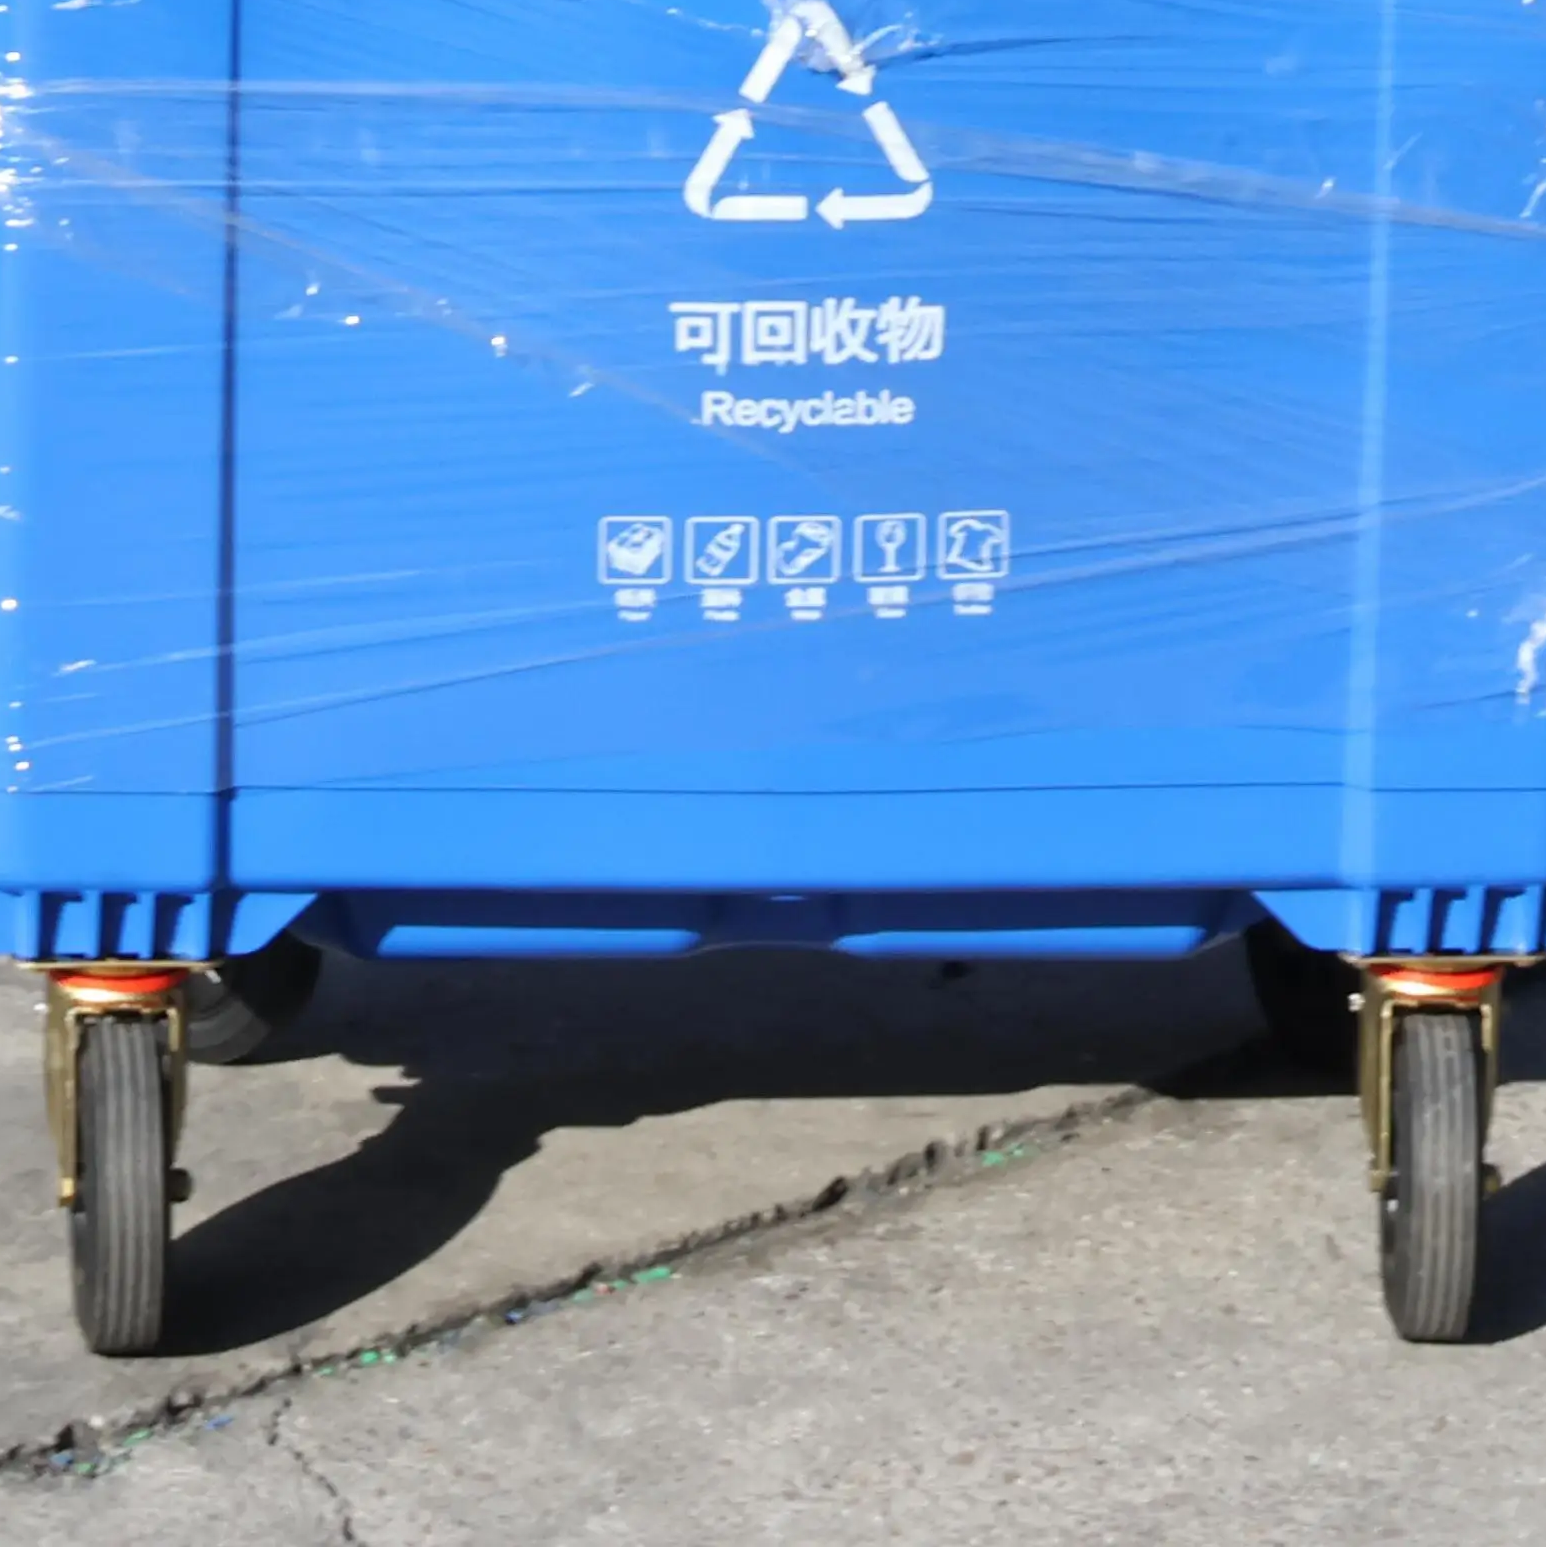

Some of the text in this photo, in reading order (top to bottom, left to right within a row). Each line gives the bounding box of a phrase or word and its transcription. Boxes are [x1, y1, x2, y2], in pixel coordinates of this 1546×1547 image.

[668, 296, 945, 370] 可回收物
[700, 389, 915, 434] Recyclable
